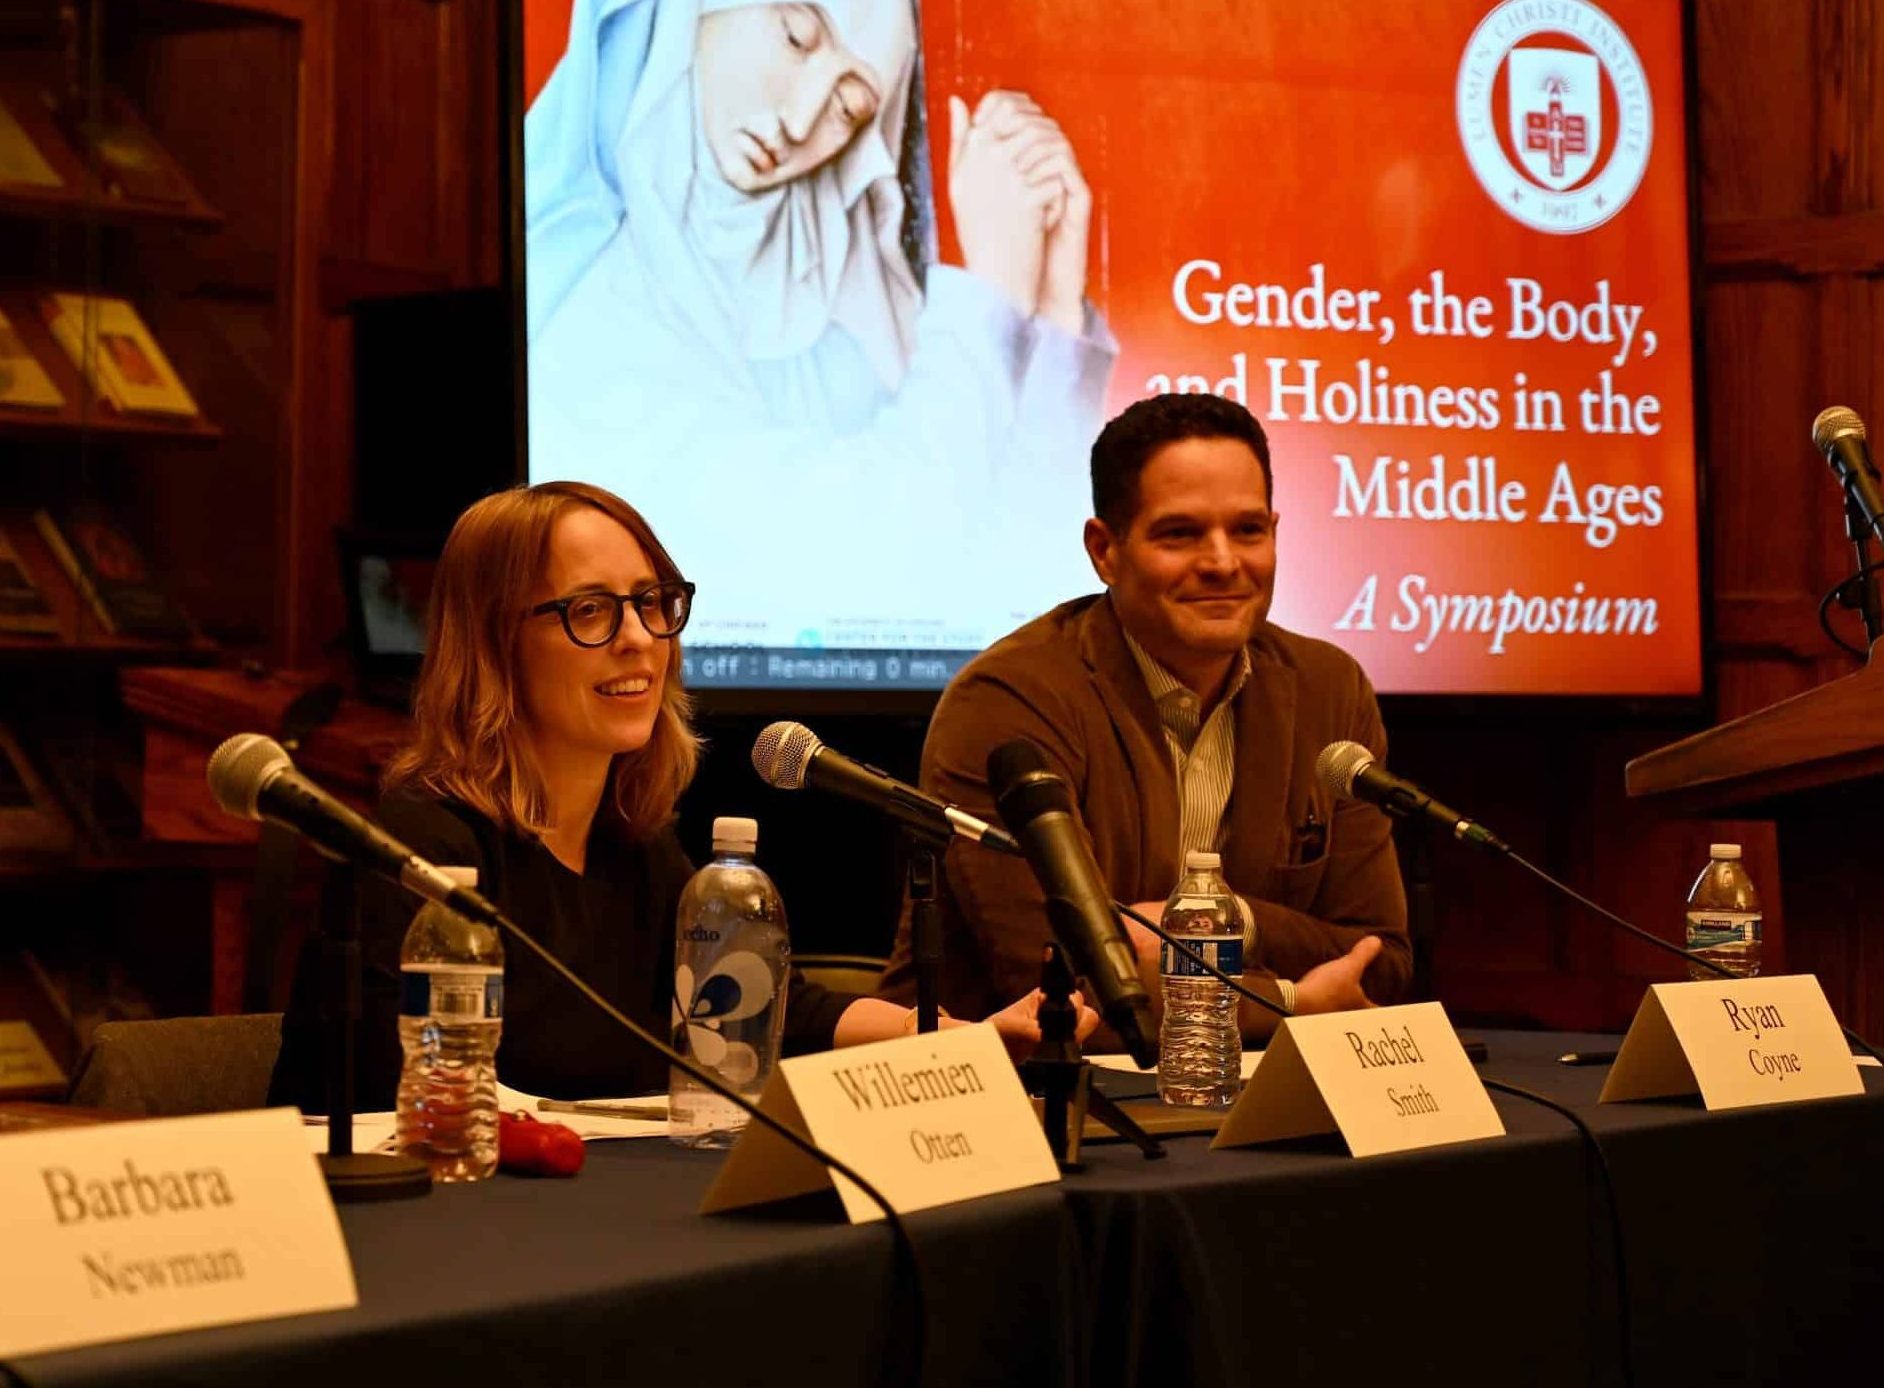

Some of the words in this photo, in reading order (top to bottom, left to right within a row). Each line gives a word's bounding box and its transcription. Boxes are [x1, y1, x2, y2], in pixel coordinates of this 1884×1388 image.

[1496, 3, 1582, 40] CHRISTI
[1172, 260, 1396, 344] Gender,
[1408, 270, 1495, 338] the
[1506, 277, 1659, 367] Body,
[1265, 357, 1500, 430] Holiness
[1513, 373, 1566, 432] in
[1580, 371, 1662, 436] the
[1332, 454, 1526, 523] Middle
[1539, 462, 1664, 548] Ages
[1333, 574, 1379, 632] A
[1391, 574, 1660, 655] Symposium
[702, 654, 741, 680] off
[768, 654, 878, 682] Remaining
[1721, 998, 1786, 1040] Ryan
[1344, 1025, 1424, 1069] Rachel
[1748, 1049, 1801, 1081] Coyne
[833, 1053, 984, 1112] Willemien
[1387, 1084, 1440, 1118] Smith
[909, 1130, 973, 1164] Otten
[42, 1158, 234, 1226] Barbara
[82, 1247, 246, 1299] Newman
